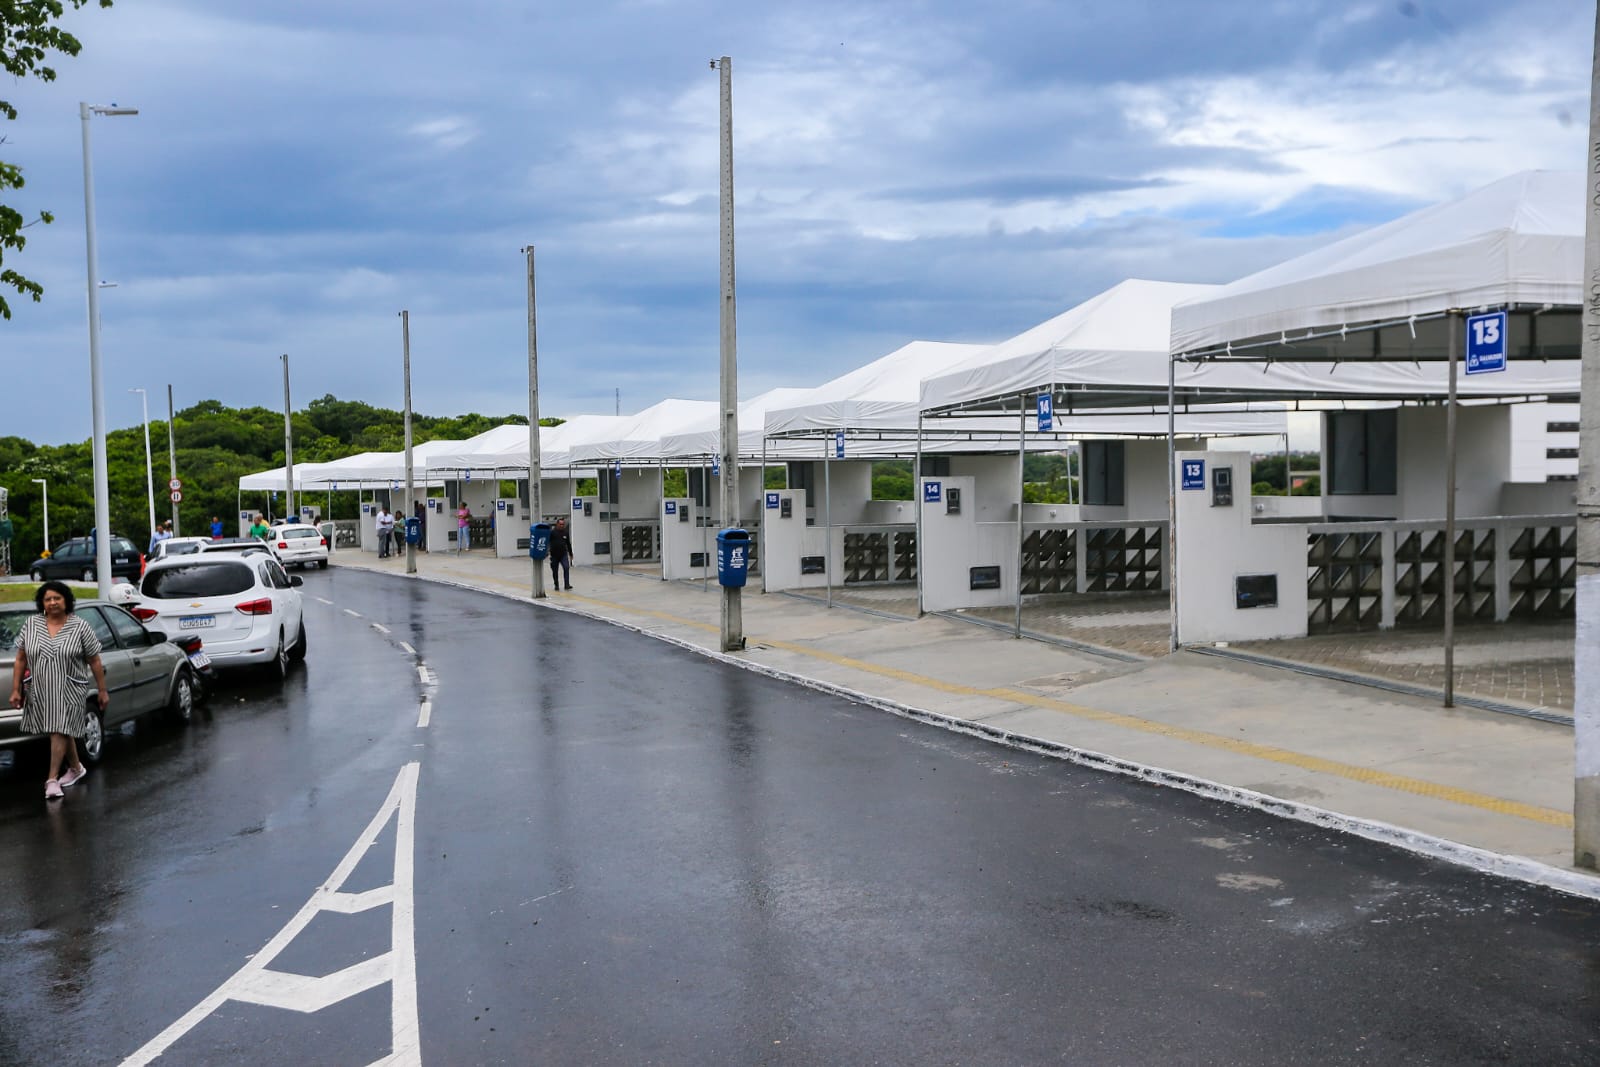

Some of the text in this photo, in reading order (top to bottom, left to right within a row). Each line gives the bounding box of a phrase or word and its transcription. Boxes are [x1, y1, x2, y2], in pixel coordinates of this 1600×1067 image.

[1472, 318, 1500, 345] 13
[1040, 399, 1050, 415] 14
[1186, 464, 1201, 476] 13
[926, 484, 938, 493] 14
